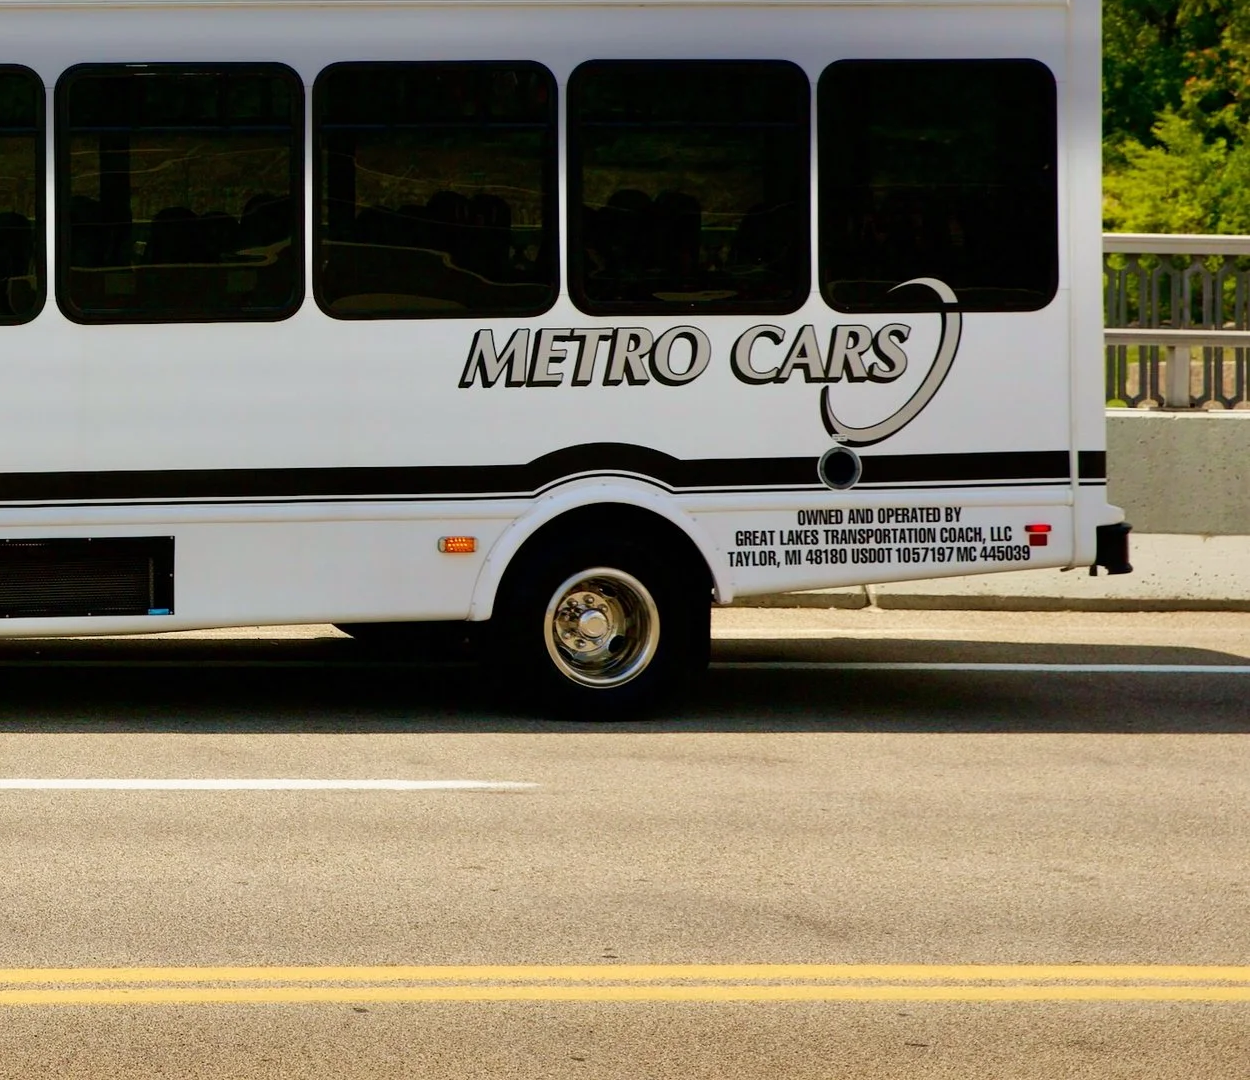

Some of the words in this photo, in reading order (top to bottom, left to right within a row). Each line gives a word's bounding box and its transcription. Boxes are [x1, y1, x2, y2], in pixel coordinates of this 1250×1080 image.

[458, 324, 712, 389] METRO
[730, 322, 912, 386] CARS
[797, 509, 843, 526] OWNED
[848, 508, 874, 525] AND
[878, 507, 941, 524] OPERATED
[945, 507, 962, 523] BY
[735, 530, 776, 547] GREAT
[780, 529, 819, 546] LAKES
[823, 527, 936, 545] TRANSPORTATION
[940, 526, 987, 544] COACH,
[990, 526, 1013, 542] LLC
[727, 550, 781, 568] TAYLOR,
[785, 550, 802, 566] MI
[805, 548, 847, 565] 48180
[851, 547, 893, 564] USDOT
[895, 546, 955, 563] 1057197
[956, 546, 977, 562] MC
[980, 545, 1031, 562] 445039
